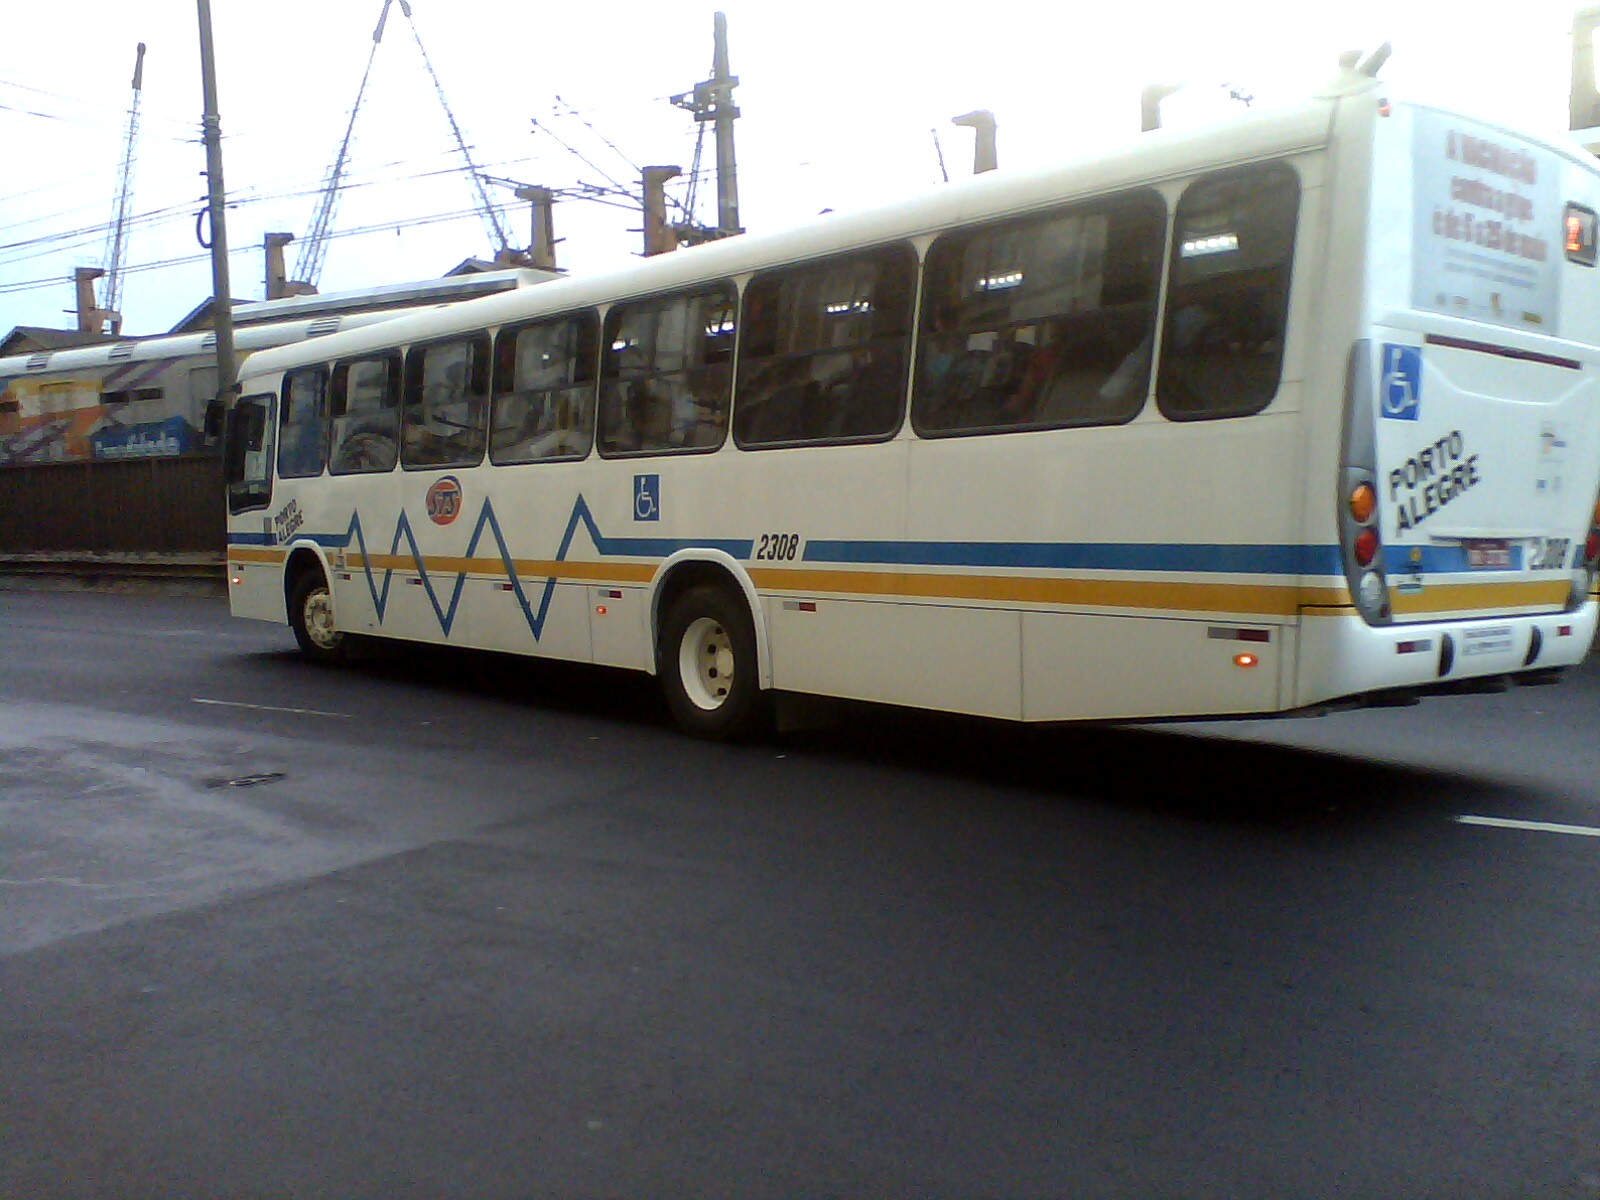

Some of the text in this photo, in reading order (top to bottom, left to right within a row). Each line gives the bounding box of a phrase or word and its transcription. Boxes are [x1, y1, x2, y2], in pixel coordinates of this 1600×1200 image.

[1389, 430, 1464, 502] PORTO
[1396, 454, 1481, 538] ALEGRE
[756, 533, 799, 561] 2308
